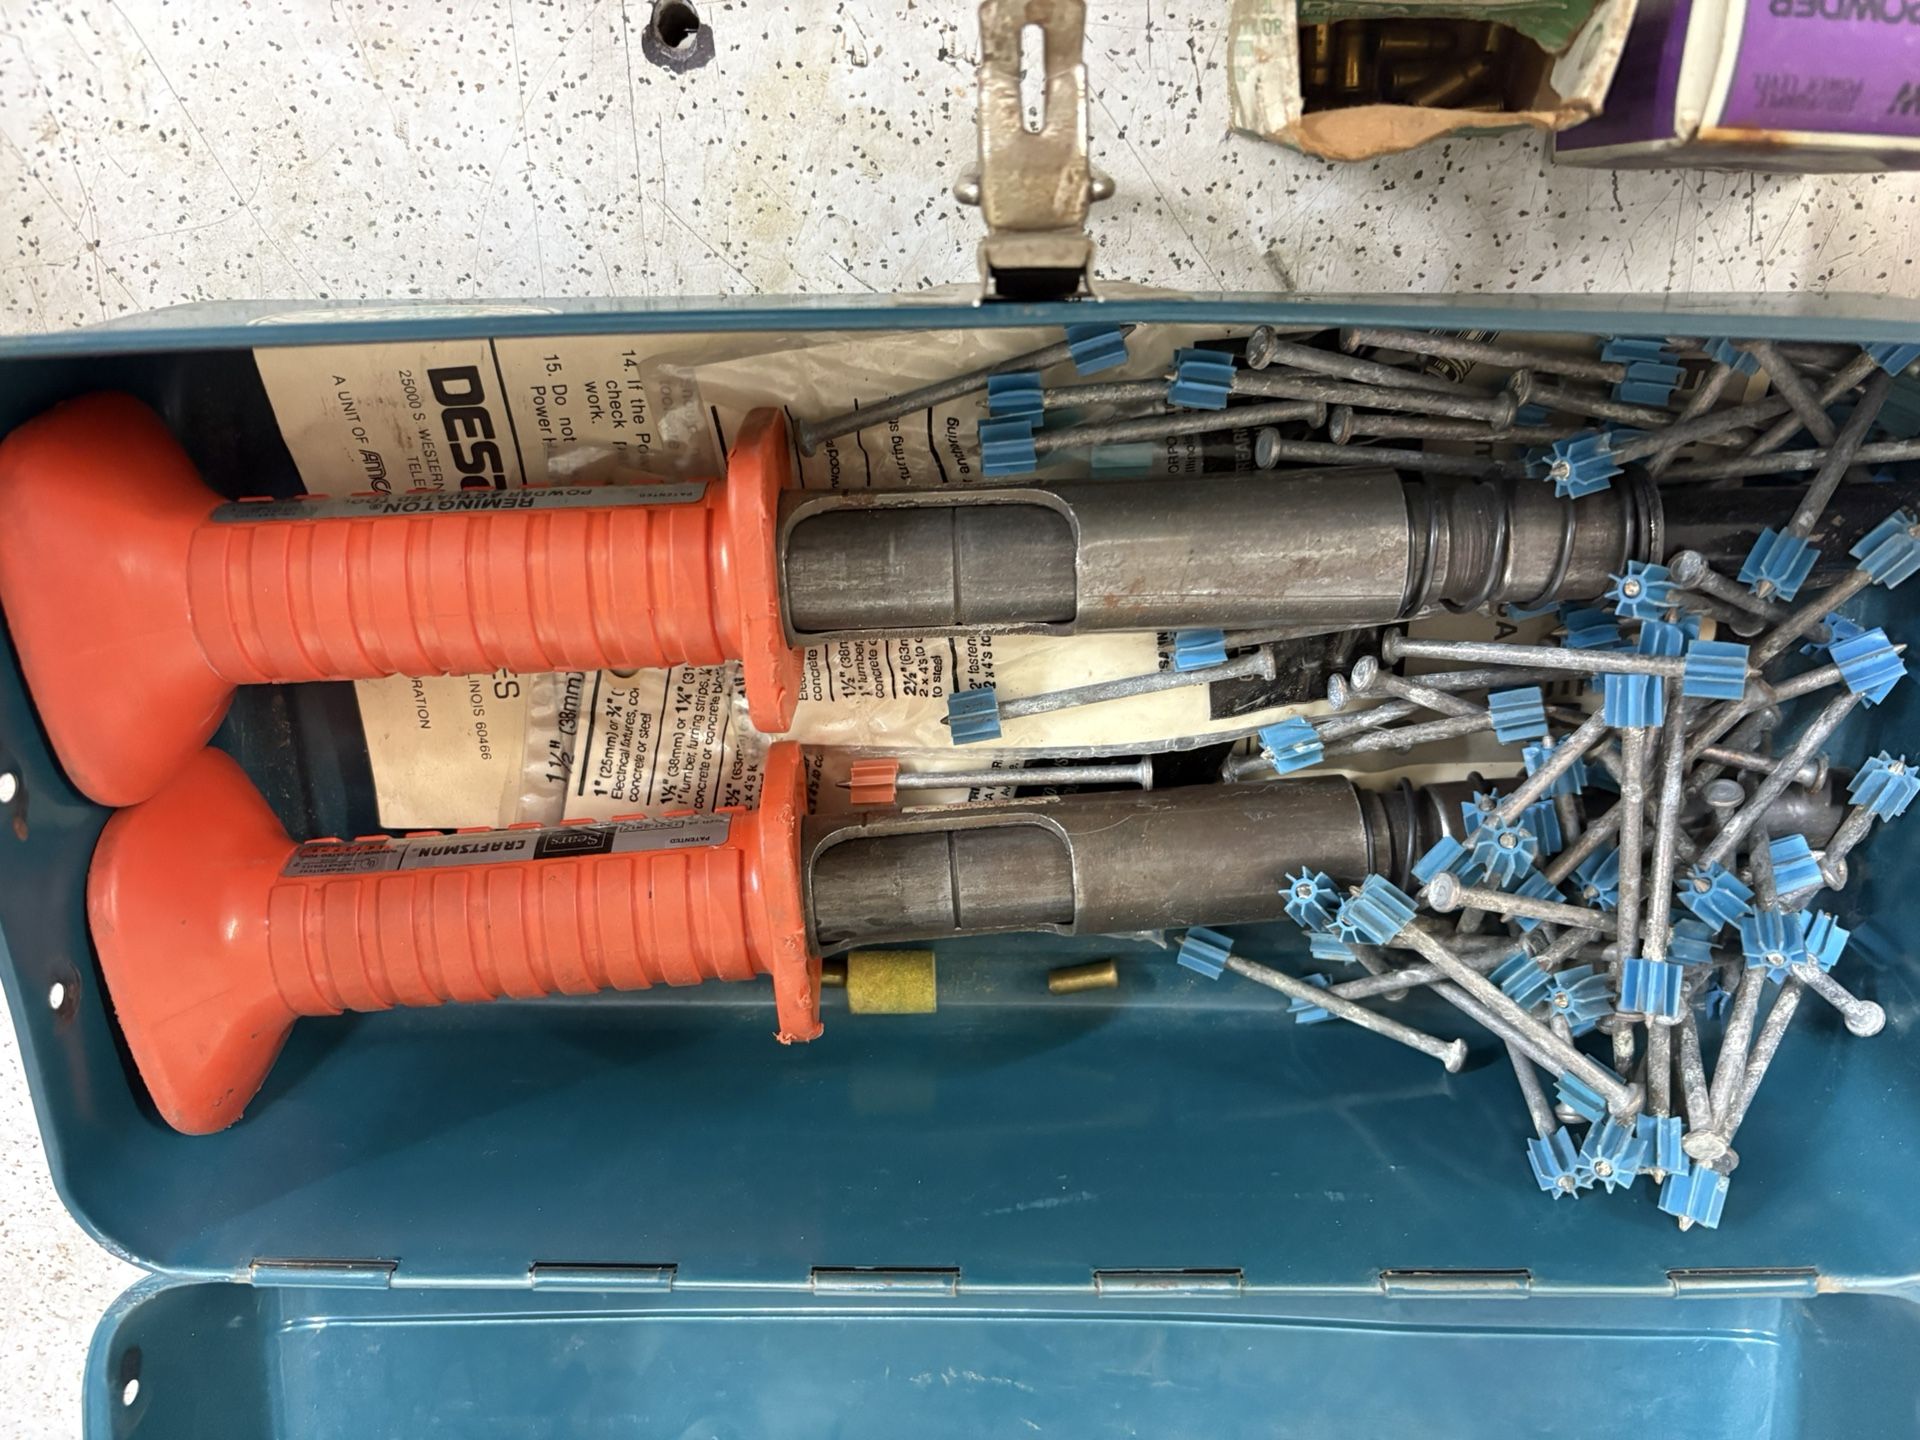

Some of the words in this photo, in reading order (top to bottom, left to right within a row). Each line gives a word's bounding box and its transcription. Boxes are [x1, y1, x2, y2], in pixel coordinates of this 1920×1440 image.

[543, 354, 562, 377] 15.
[622, 350, 637, 372] 14.
[332, 375, 346, 387] A
[626, 380, 643, 391] If
[338, 391, 361, 422] UNIT
[552, 384, 568, 406] Do
[584, 381, 605, 424] work.
[605, 380, 627, 429] check
[530, 386, 553, 434] Power
[630, 399, 645, 425] the
[352, 427, 369, 445] OF
[399, 369, 423, 410] 25000
[418, 427, 445, 492] WESTERN
[559, 417, 577, 443] not
[891, 435, 911, 481] furring
[946, 416, 970, 475] anchoring
[407, 455, 427, 491] TELE
[914, 646, 925, 658] to
[981, 651, 993, 669] 4's
[682, 667, 696, 684] (31
[807, 648, 823, 702] concrete
[868, 648, 885, 699] concrete
[917, 659, 929, 675] 4's
[930, 655, 943, 683] steel
[919, 688, 929, 698] 2
[921, 678, 929, 686] x
[931, 686, 943, 699] to
[411, 677, 432, 730] RATION
[620, 709, 639, 749] fixtures,
[640, 713, 652, 740] steel
[676, 717, 686, 729] or
[688, 714, 706, 751] furring
[705, 695, 721, 746] concrete
[475, 721, 493, 761] 60466
[599, 732, 620, 779] (25mm)
[610, 719, 620, 732] or
[638, 741, 647, 753] or
[702, 747, 714, 761] or
[667, 732, 686, 778] (38mm)
[611, 747, 631, 801] Electrical
[629, 754, 646, 803] concrete
[679, 752, 698, 795] lumber,
[694, 760, 711, 810] concrete
[418, 838, 527, 857] CRAFTSMAN
[551, 832, 599, 846] Sears
[669, 835, 711, 844] PATENTED
